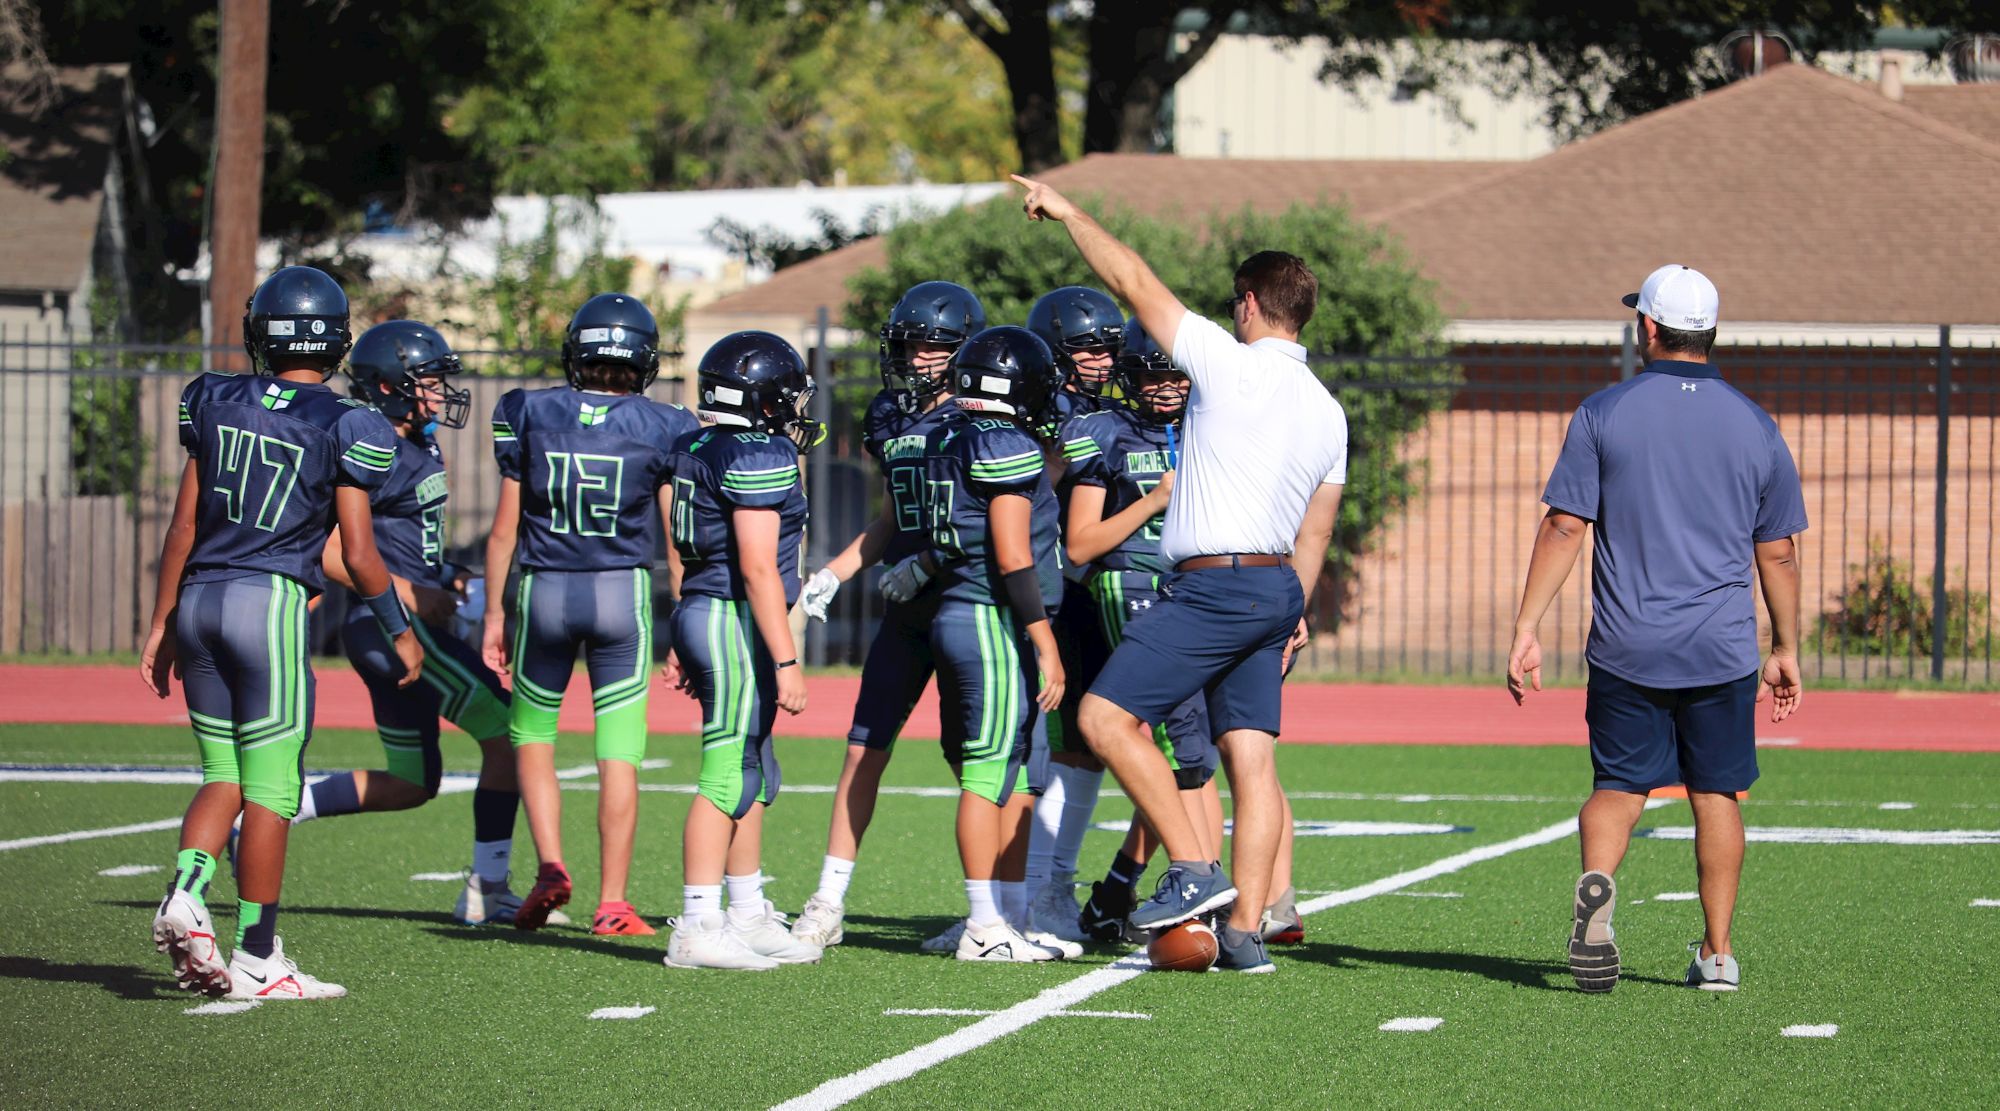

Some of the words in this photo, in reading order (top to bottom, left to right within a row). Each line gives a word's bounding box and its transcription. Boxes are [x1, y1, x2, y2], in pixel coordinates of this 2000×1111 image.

[288, 341, 327, 352] schutt
[213, 424, 305, 534] 47
[545, 451, 623, 538] 12
[891, 466, 926, 532] 2
